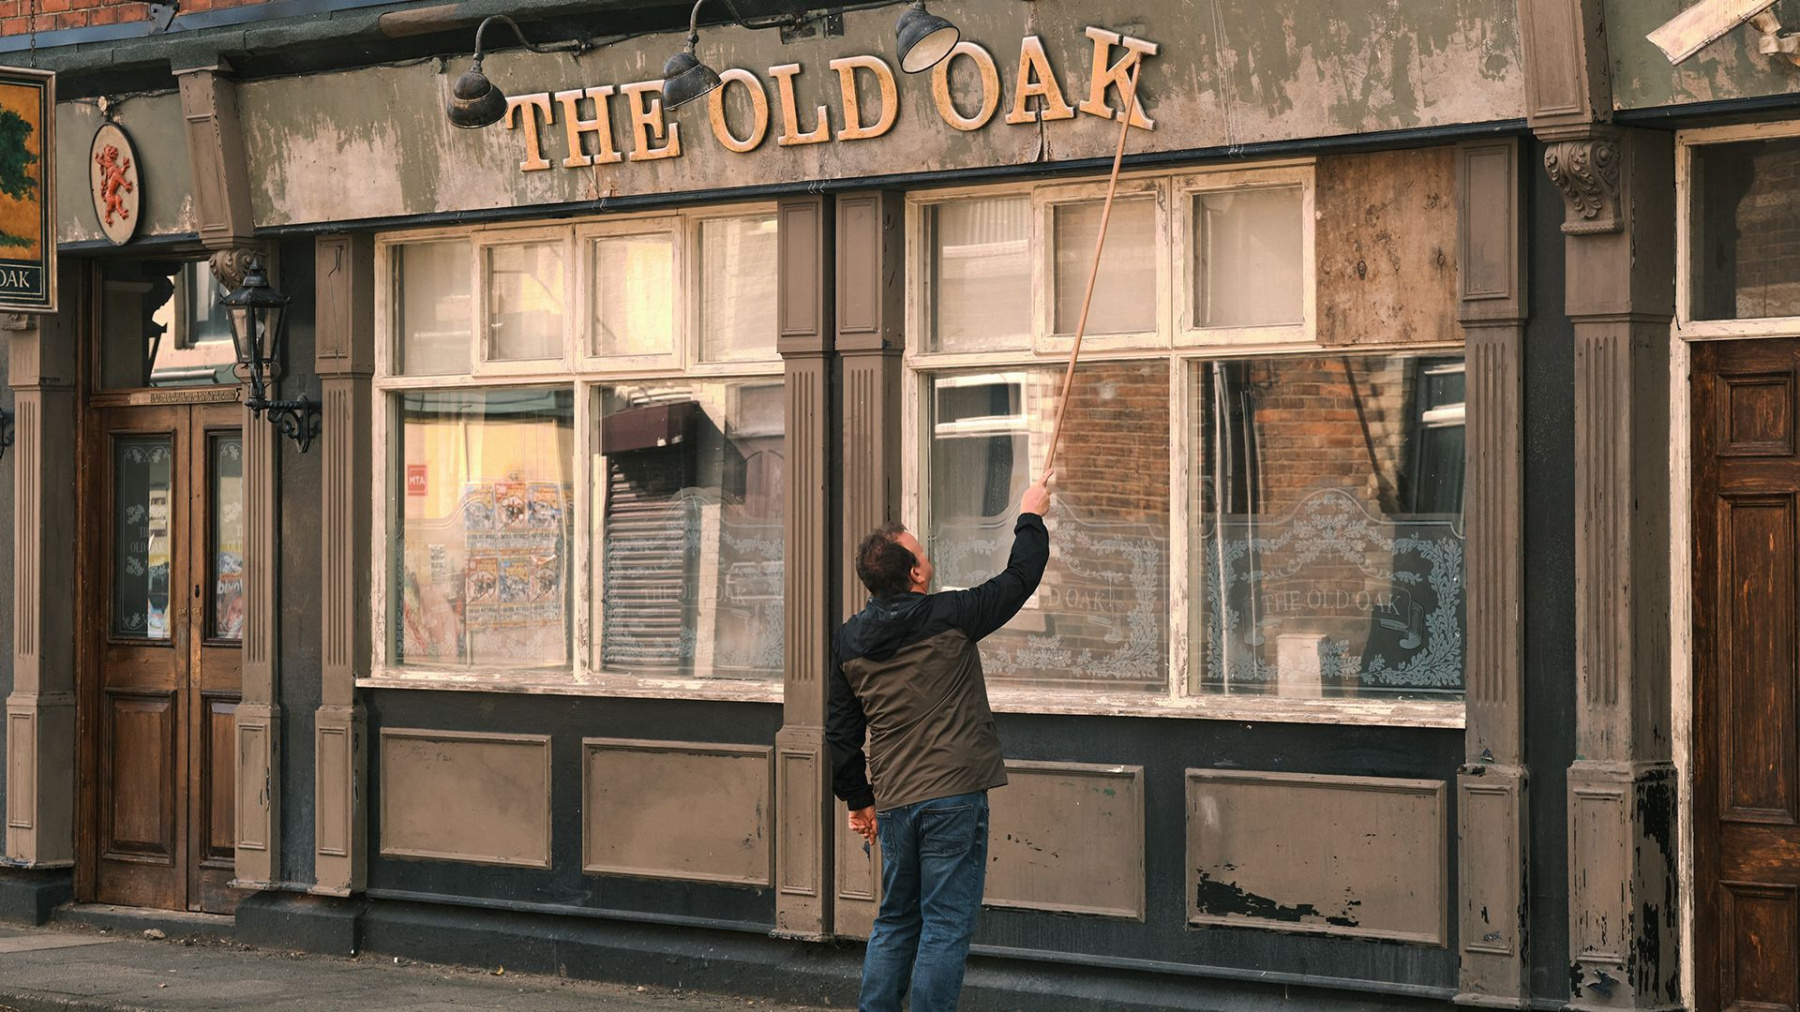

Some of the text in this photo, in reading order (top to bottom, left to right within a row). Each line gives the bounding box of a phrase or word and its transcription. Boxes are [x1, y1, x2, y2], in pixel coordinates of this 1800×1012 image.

[504, 26, 1159, 172] THE OLD OAK
[1261, 589, 1401, 616] THE OLD OAK
